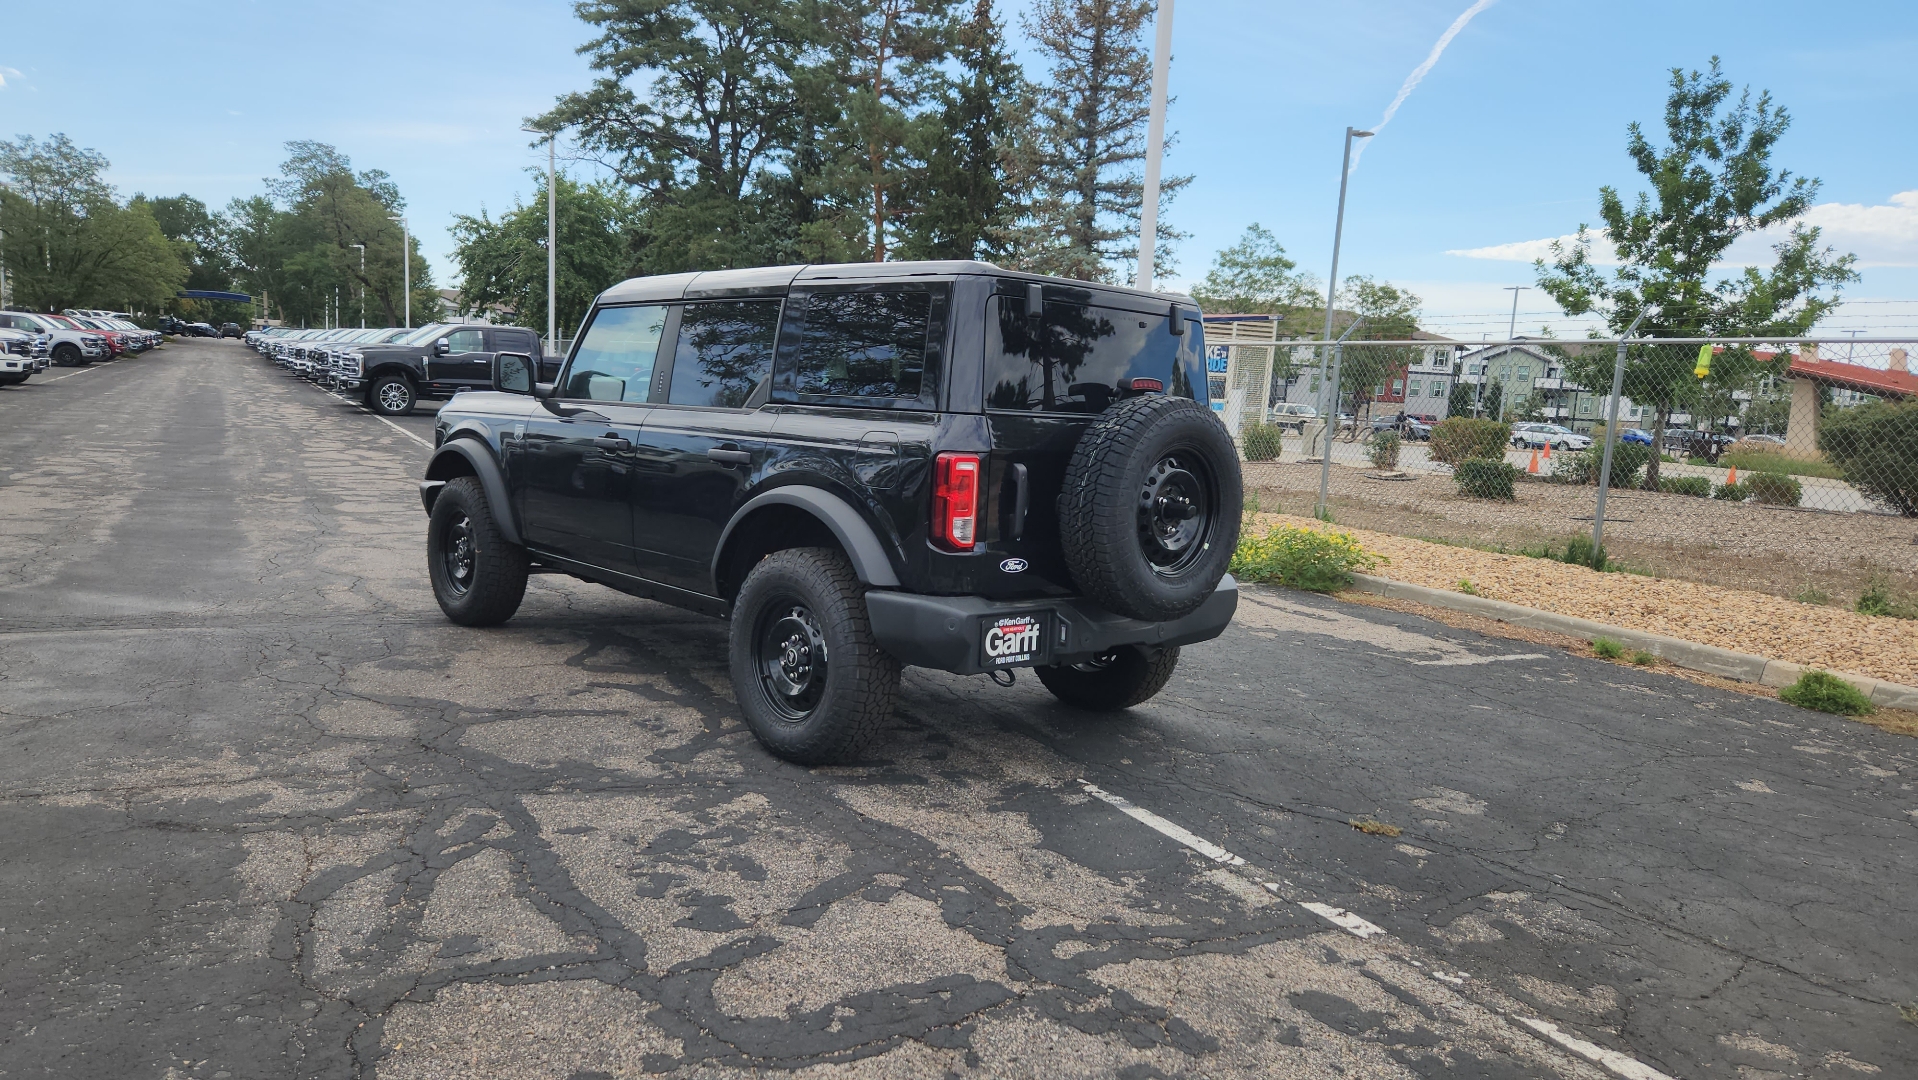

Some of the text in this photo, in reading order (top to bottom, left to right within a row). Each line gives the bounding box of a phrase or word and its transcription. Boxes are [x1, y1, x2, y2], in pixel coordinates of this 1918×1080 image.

[1206, 345, 1221, 359] KE
[1207, 358, 1228, 372] IDE
[1004, 616, 1031, 626] Ken Garff
[985, 624, 1039, 657] Garff
